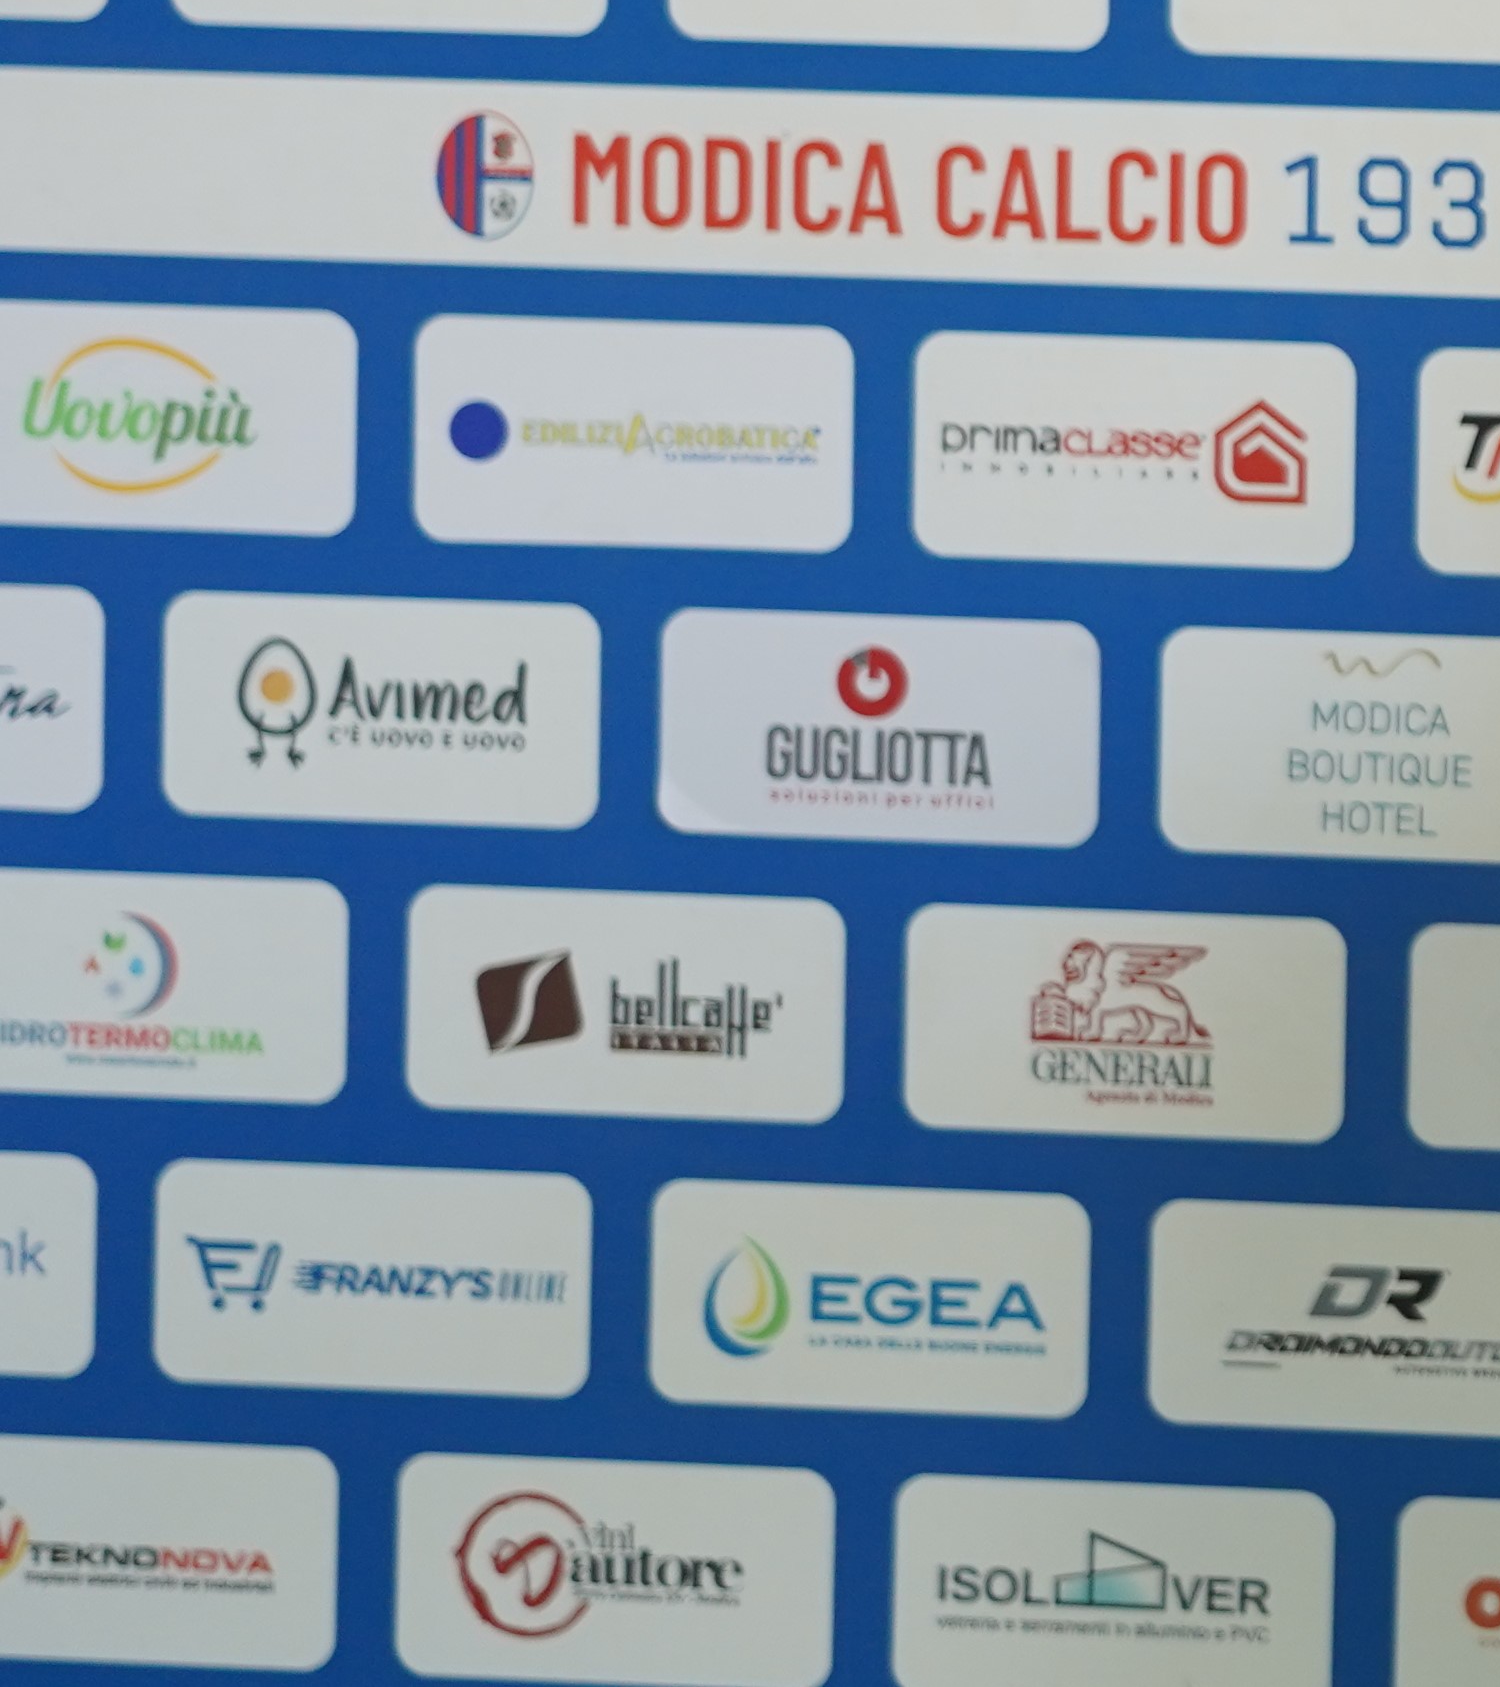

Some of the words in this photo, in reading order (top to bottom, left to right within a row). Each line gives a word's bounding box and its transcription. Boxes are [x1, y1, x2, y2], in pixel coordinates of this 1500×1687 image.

[572, 132, 903, 237] MODICA
[935, 144, 1248, 248] CALCIO
[327, 656, 528, 726] Avimed
[1310, 700, 1451, 738] MODICA
[764, 723, 992, 788] GUGLIOTTA
[1285, 747, 1473, 789] BOUTIQUE
[1320, 800, 1438, 838] HOTEL
[1029, 1047, 1212, 1089] GENERALI
[315, 1262, 493, 1301] FRANZY'S
[809, 1273, 1045, 1332] EGEA
[25, 1539, 273, 1574] TEKNONOVA
